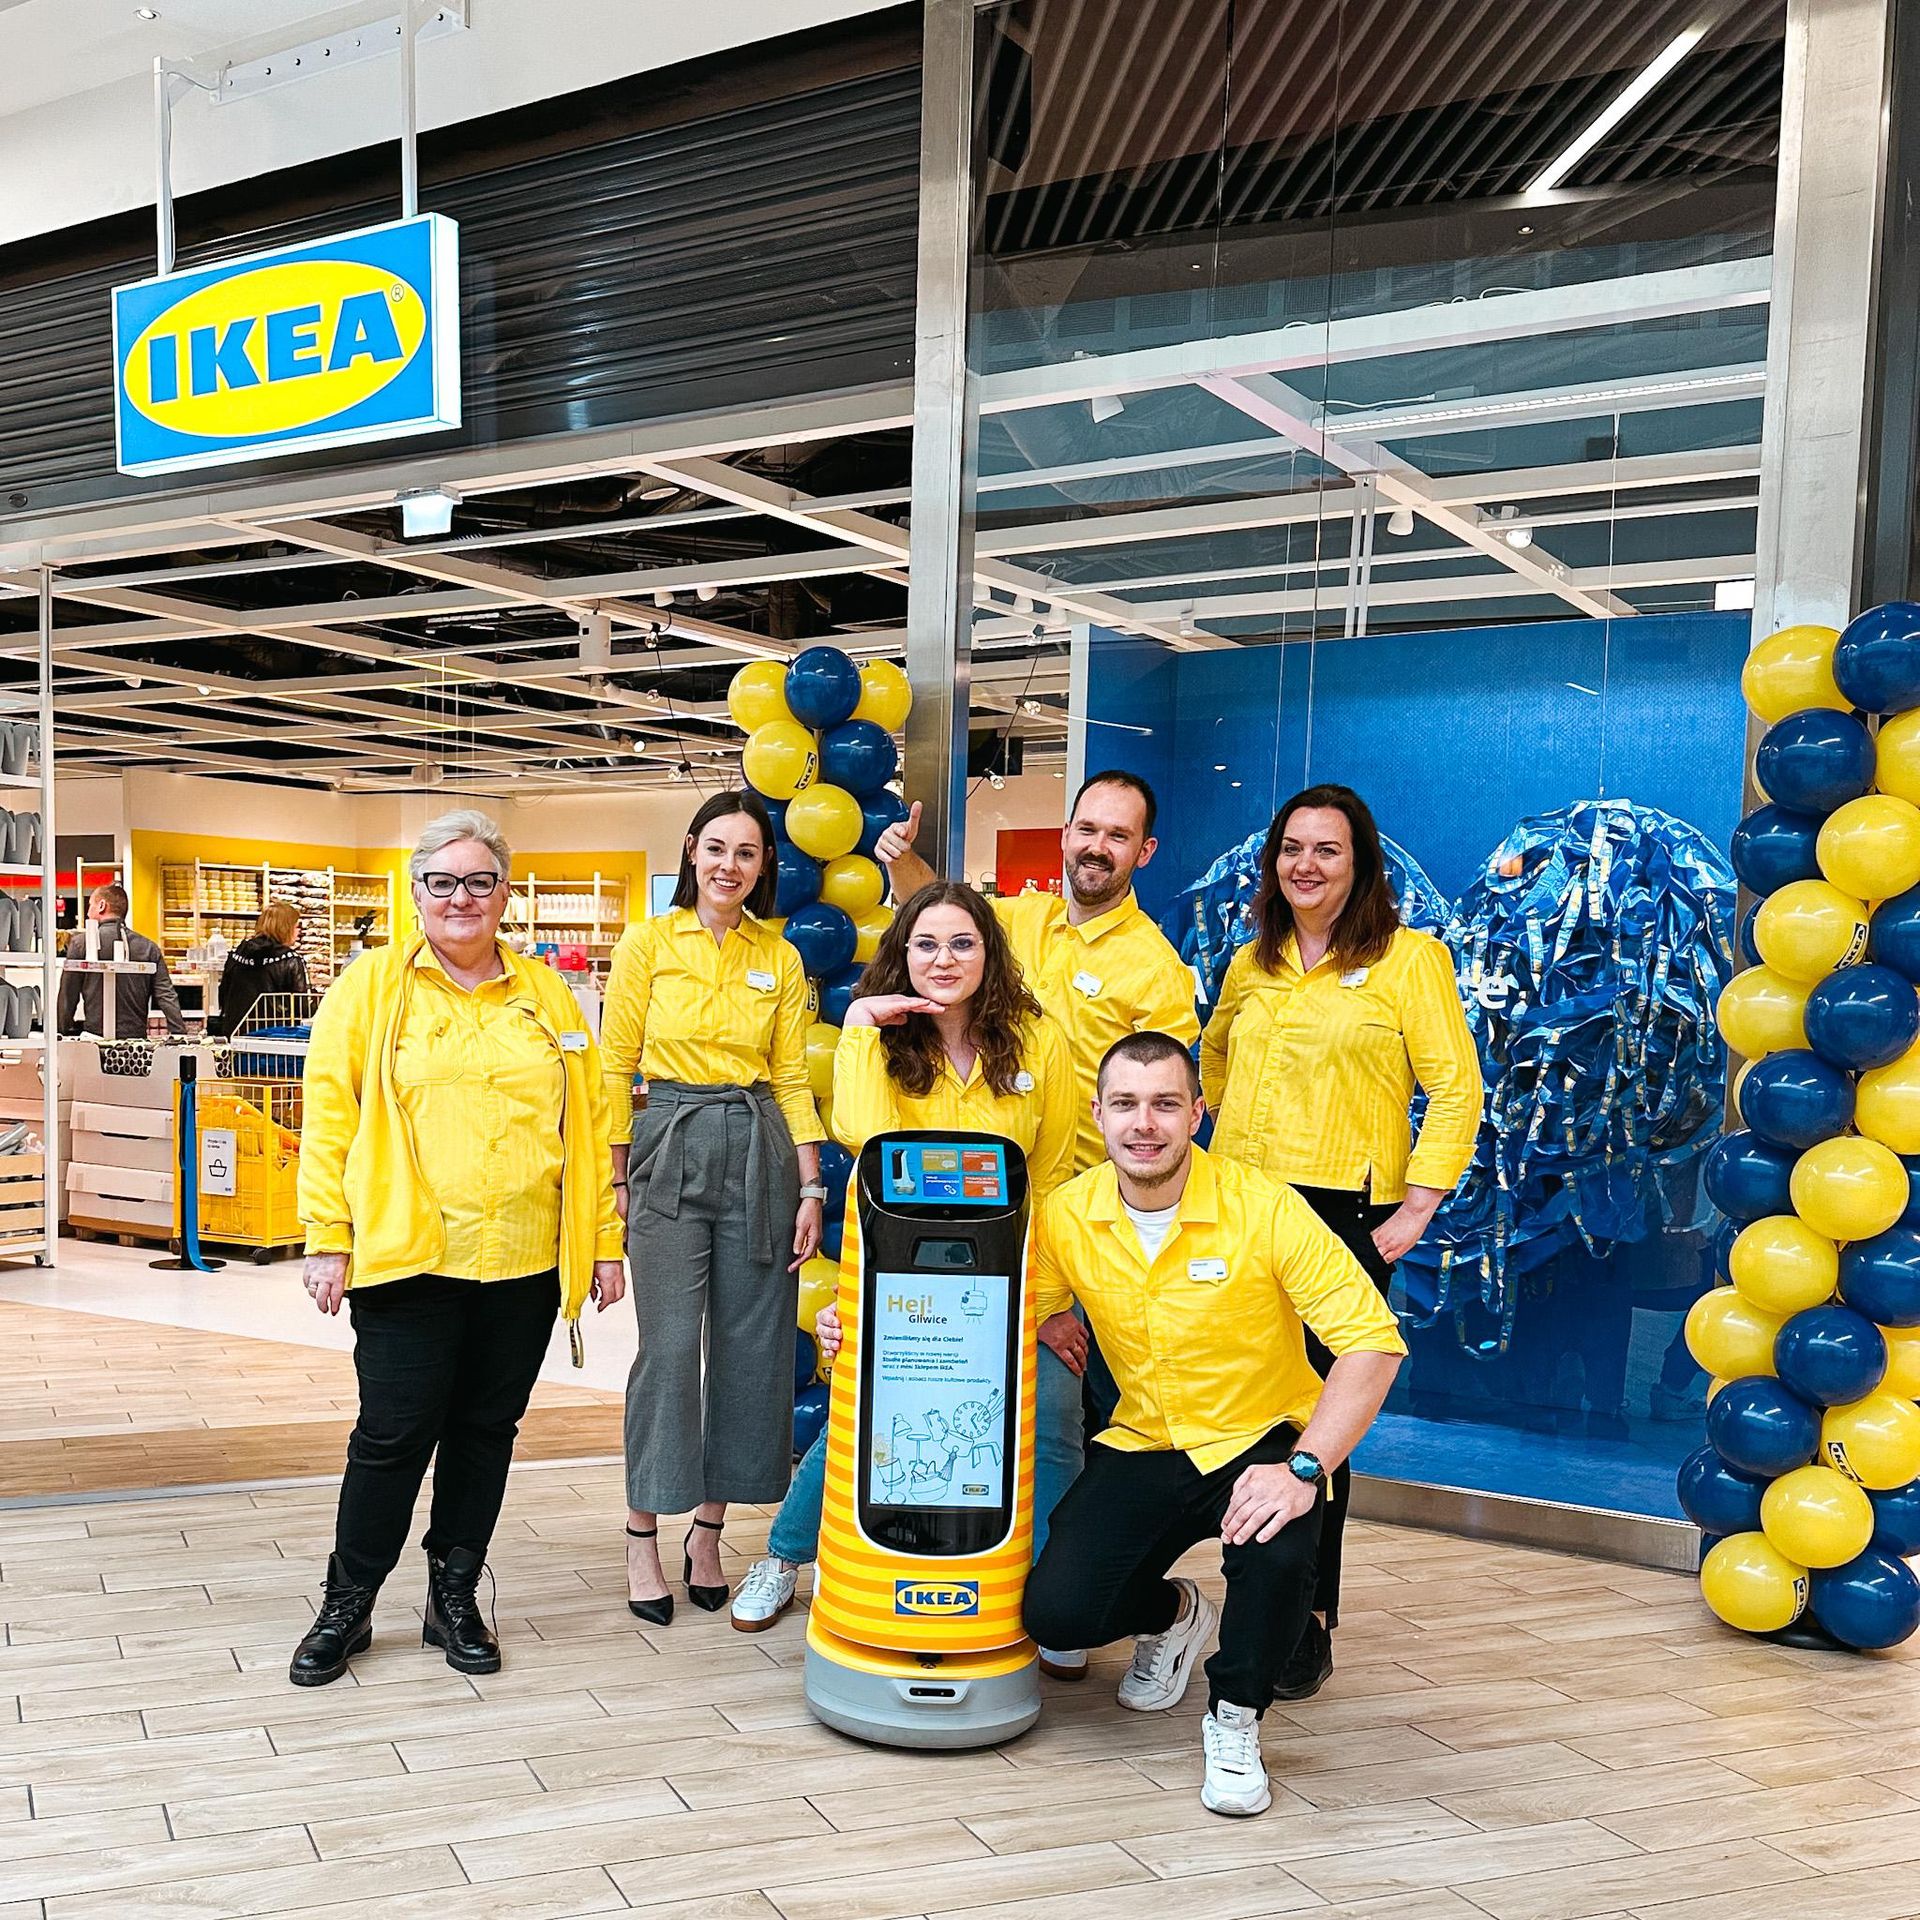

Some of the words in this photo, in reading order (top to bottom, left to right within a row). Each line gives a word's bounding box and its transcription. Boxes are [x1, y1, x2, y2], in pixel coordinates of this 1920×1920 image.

[149, 290, 404, 405] IKEA
[800, 757, 815, 787] IKEA
[1842, 929, 1864, 966] IKEA
[887, 1294, 933, 1316] Hej!
[908, 1314, 948, 1325] Gliwice
[1833, 1447, 1855, 1479] IKEA
[904, 1591, 972, 1605] IKEA
[1796, 1582, 1805, 1617] IKEA
